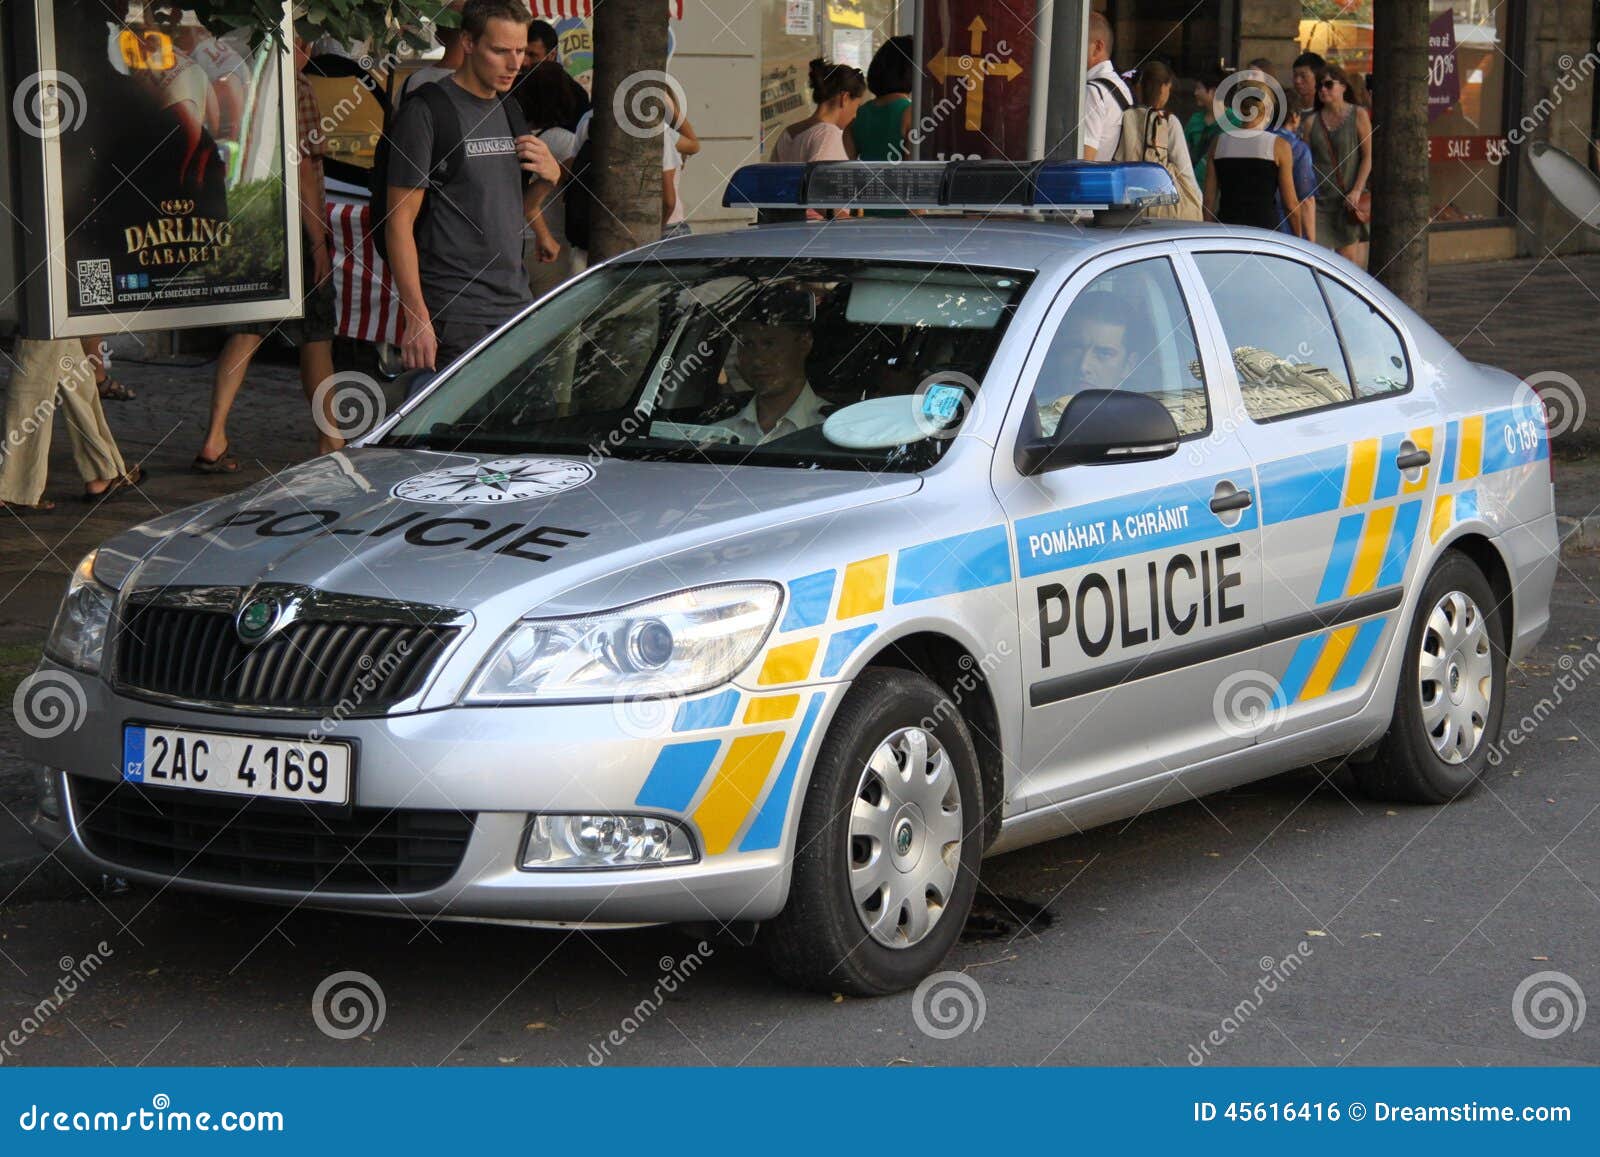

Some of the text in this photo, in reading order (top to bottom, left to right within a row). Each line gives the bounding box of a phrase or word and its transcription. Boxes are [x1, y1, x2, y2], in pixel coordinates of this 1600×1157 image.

[562, 34, 591, 54] ZDE
[1448, 139, 1471, 158] SALE
[124, 216, 234, 254] DARLING
[138, 247, 223, 266] CABARET
[1516, 420, 1538, 451] 158
[1029, 505, 1189, 558] POMÁHAT A CHRÁNIT
[1037, 543, 1245, 668] POLICIE
[127, 762, 142, 776] CZ
[151, 735, 329, 795] 2AC 4169
